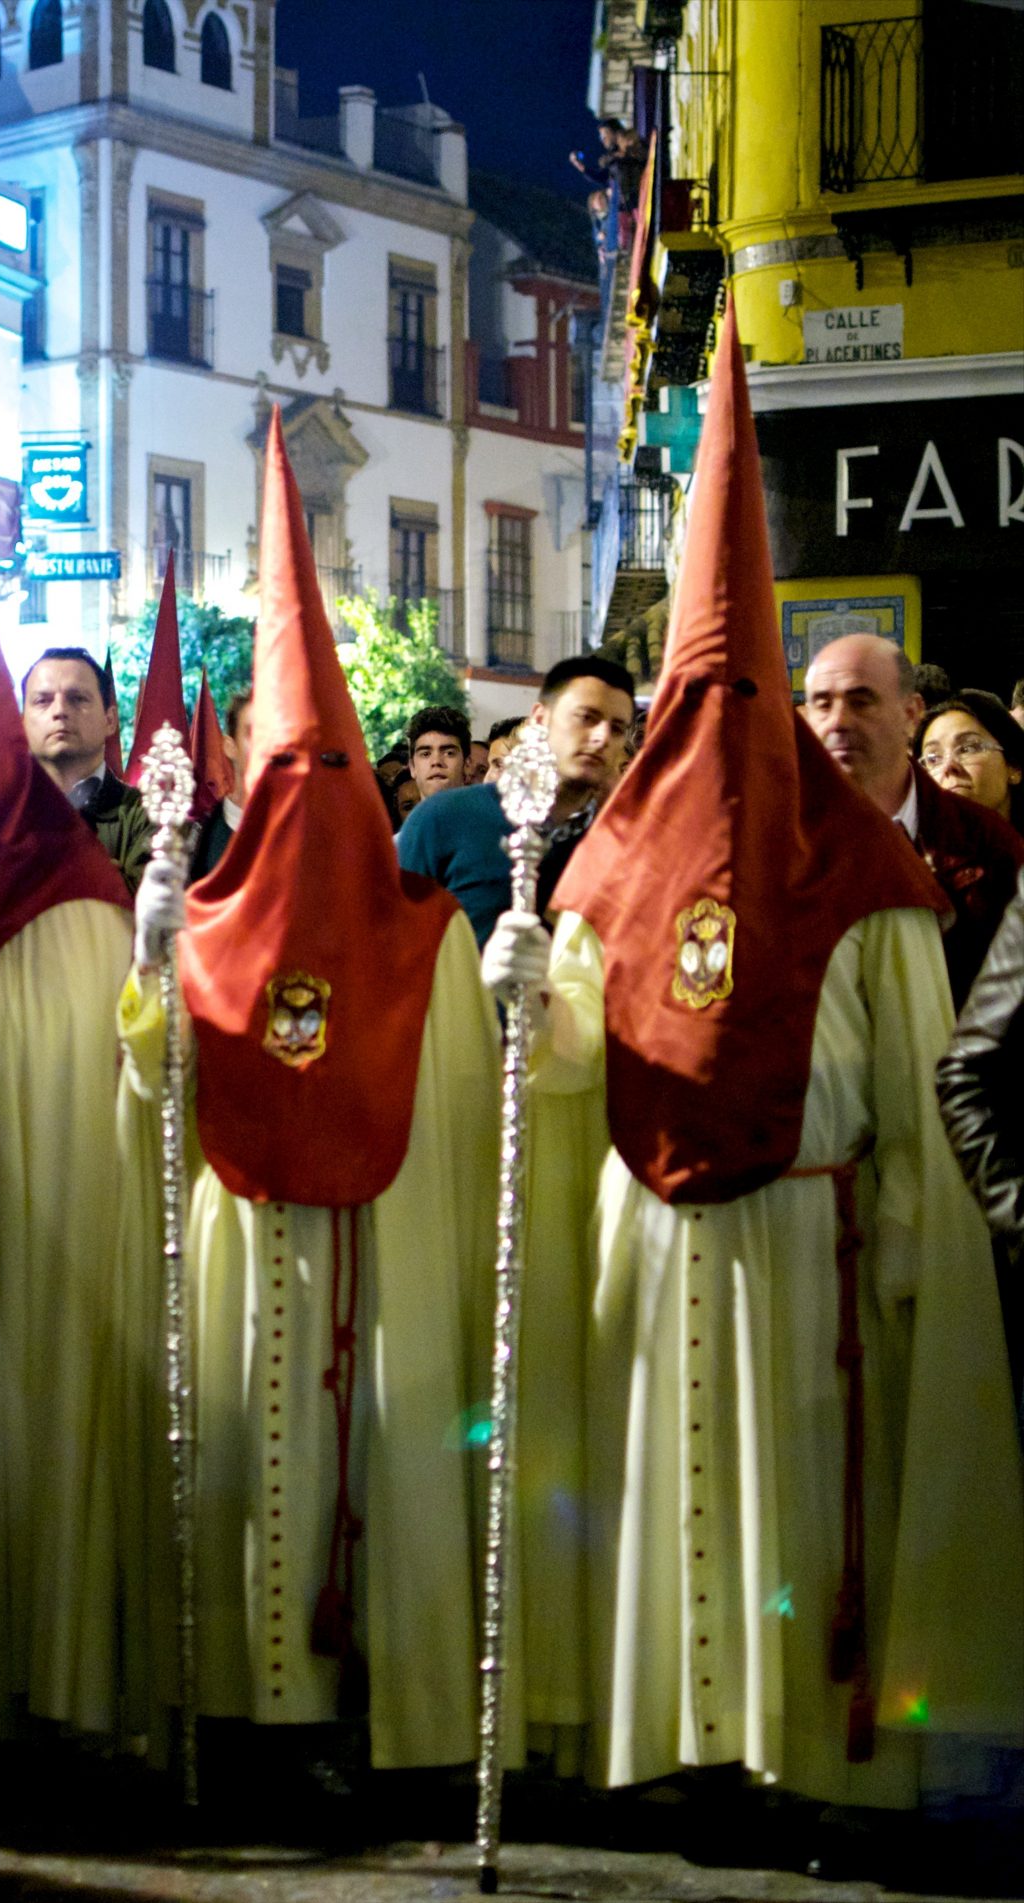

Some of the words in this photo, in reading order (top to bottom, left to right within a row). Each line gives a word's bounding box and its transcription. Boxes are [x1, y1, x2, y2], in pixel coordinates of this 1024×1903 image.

[824, 309, 881, 330] CALLE
[805, 342, 902, 361] PLACENTINES
[836, 437, 1024, 537] FAR
